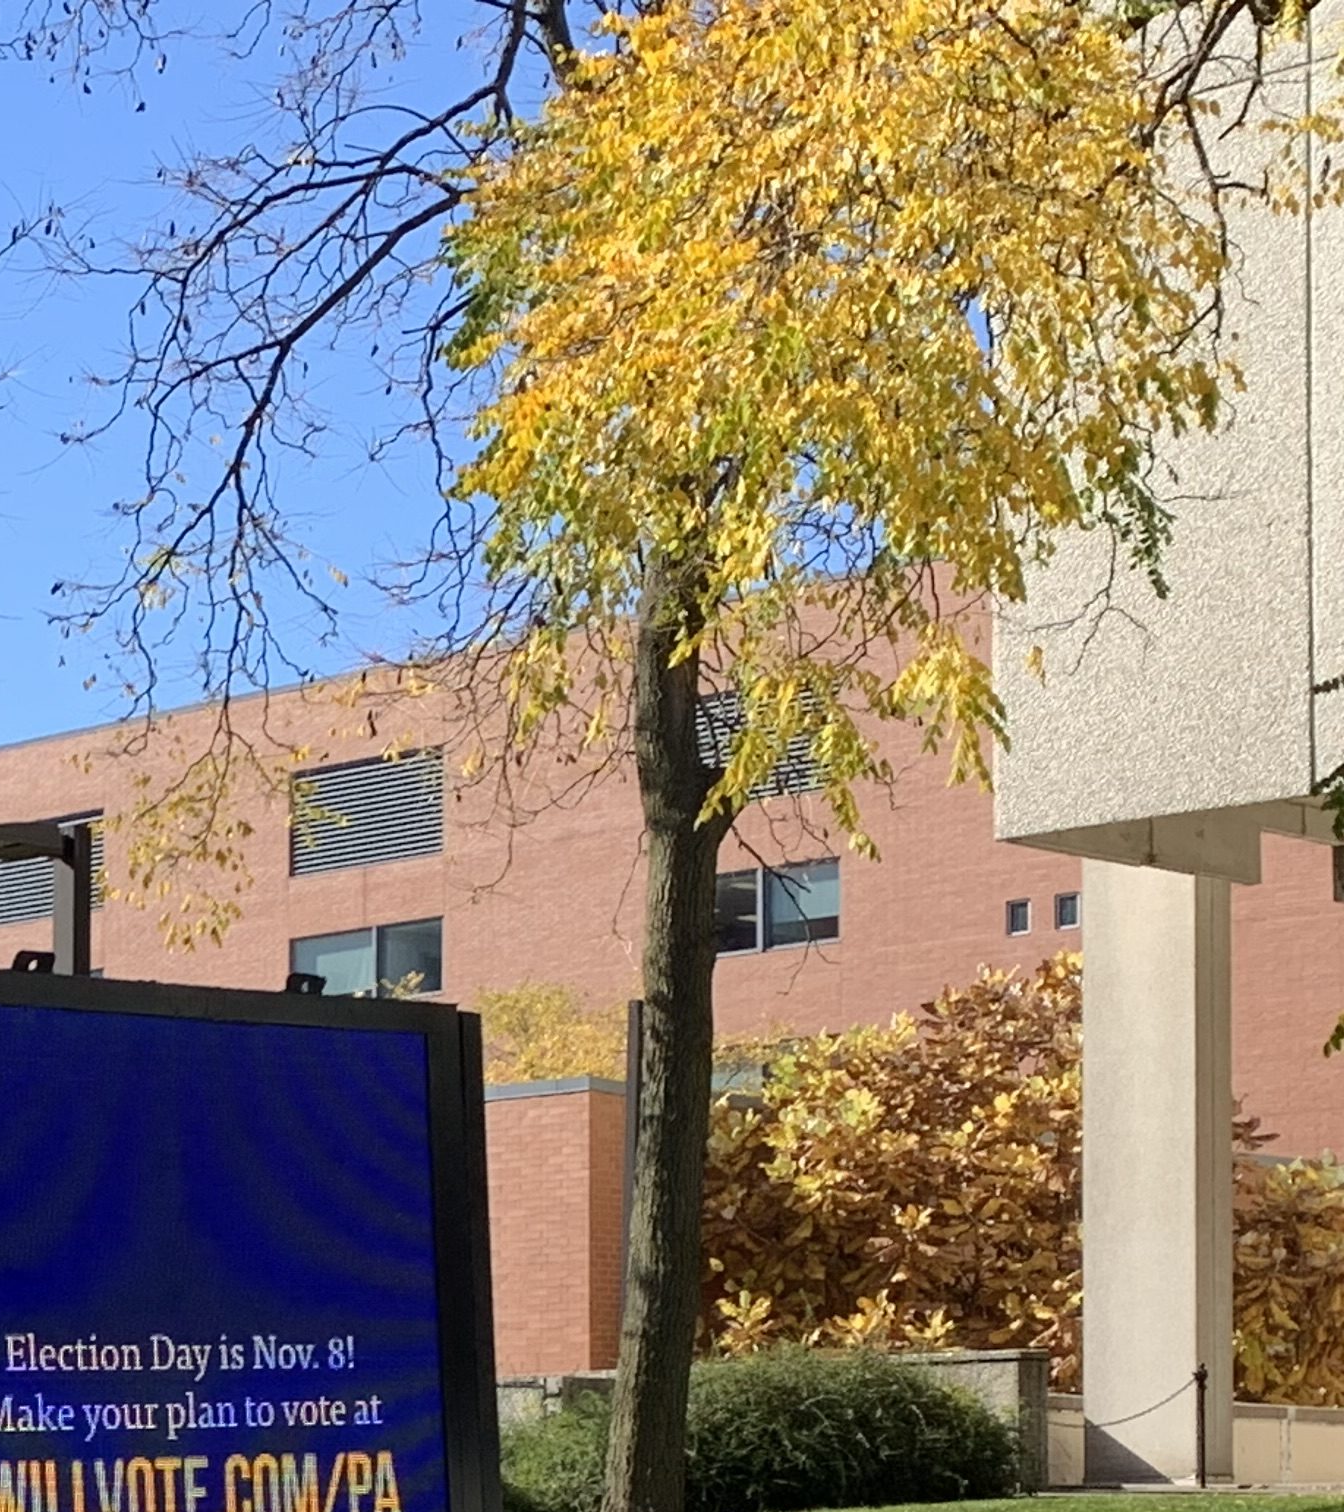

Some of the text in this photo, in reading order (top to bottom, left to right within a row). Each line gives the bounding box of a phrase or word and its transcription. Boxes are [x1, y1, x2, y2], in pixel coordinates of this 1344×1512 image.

[4, 1333, 355, 1382] Election Day is Nov. 8!
[83, 1404, 160, 1442] your
[166, 1391, 238, 1440] plan
[245, 1396, 276, 1428] to
[281, 1395, 347, 1427] vote
[353, 1394, 384, 1426] at
